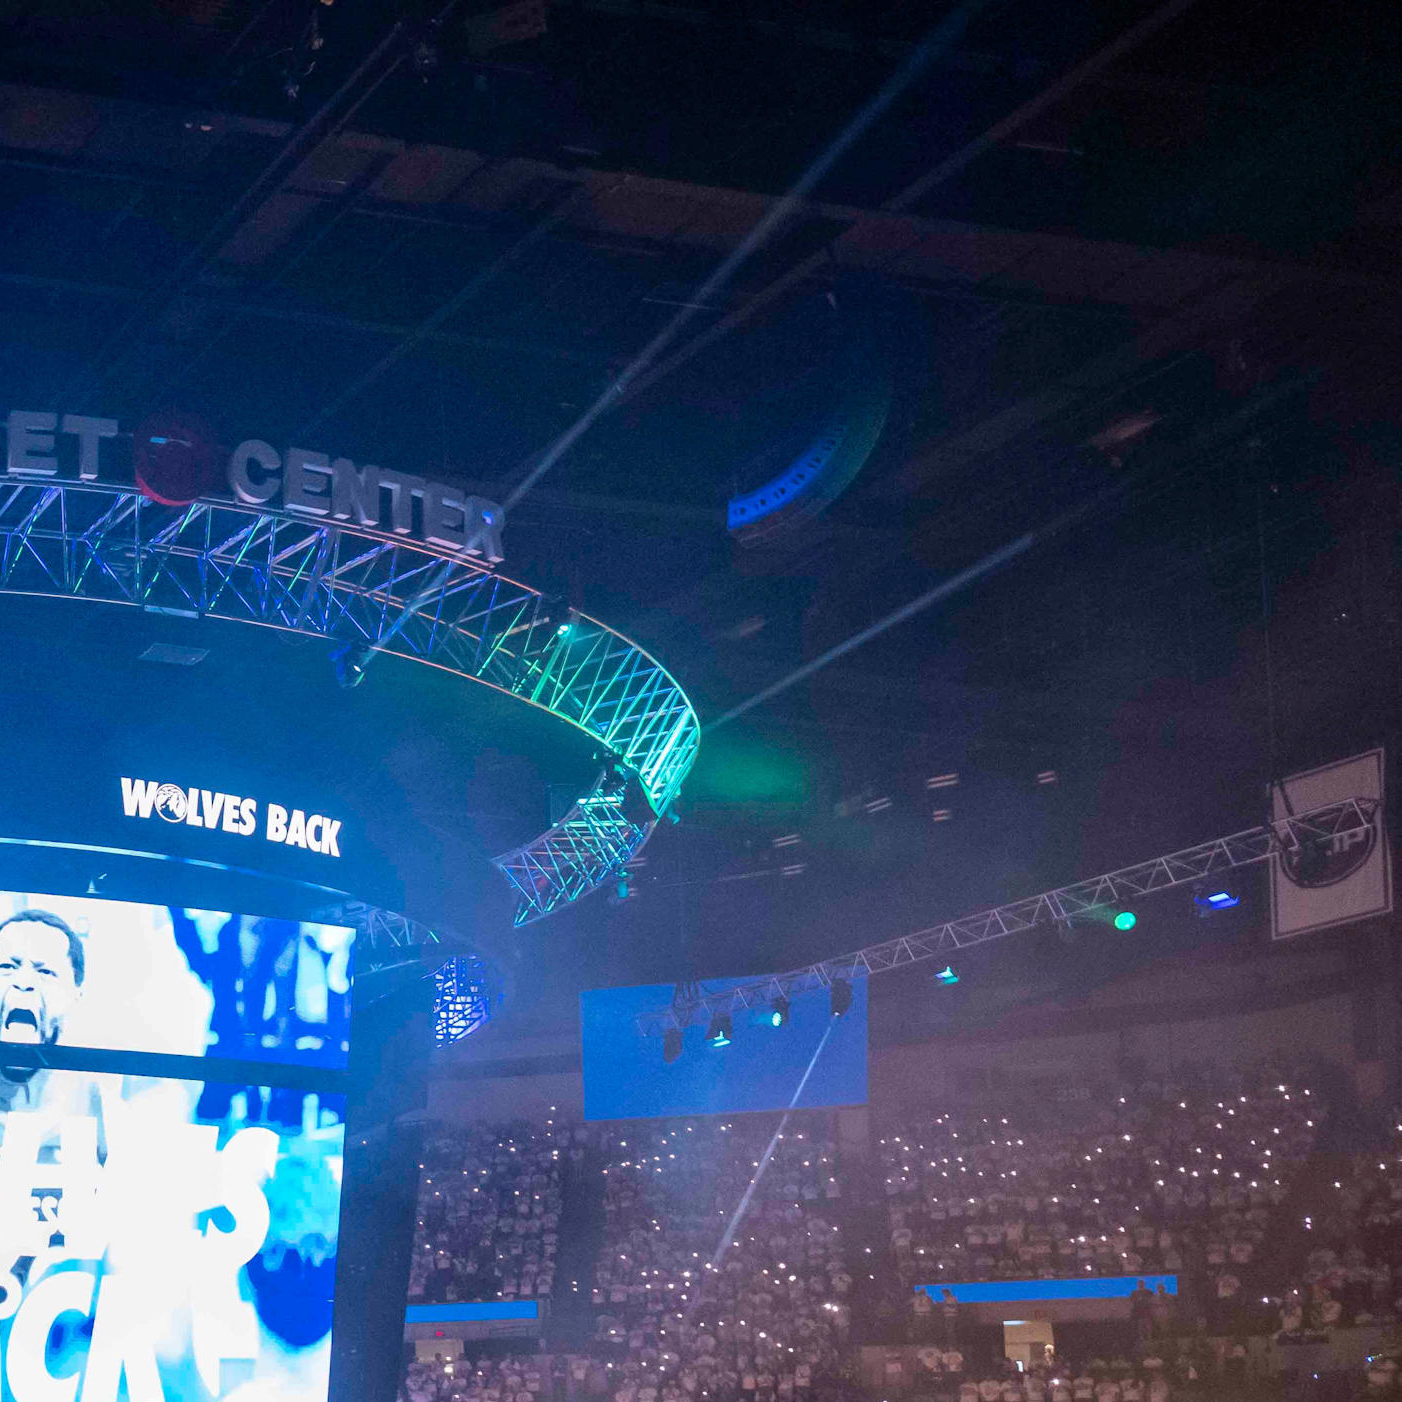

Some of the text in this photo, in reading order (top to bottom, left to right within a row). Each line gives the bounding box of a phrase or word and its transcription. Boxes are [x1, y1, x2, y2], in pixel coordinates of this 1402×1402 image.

[228, 438, 507, 563] CENTER
[119, 777, 341, 858] WOLVES BACK
